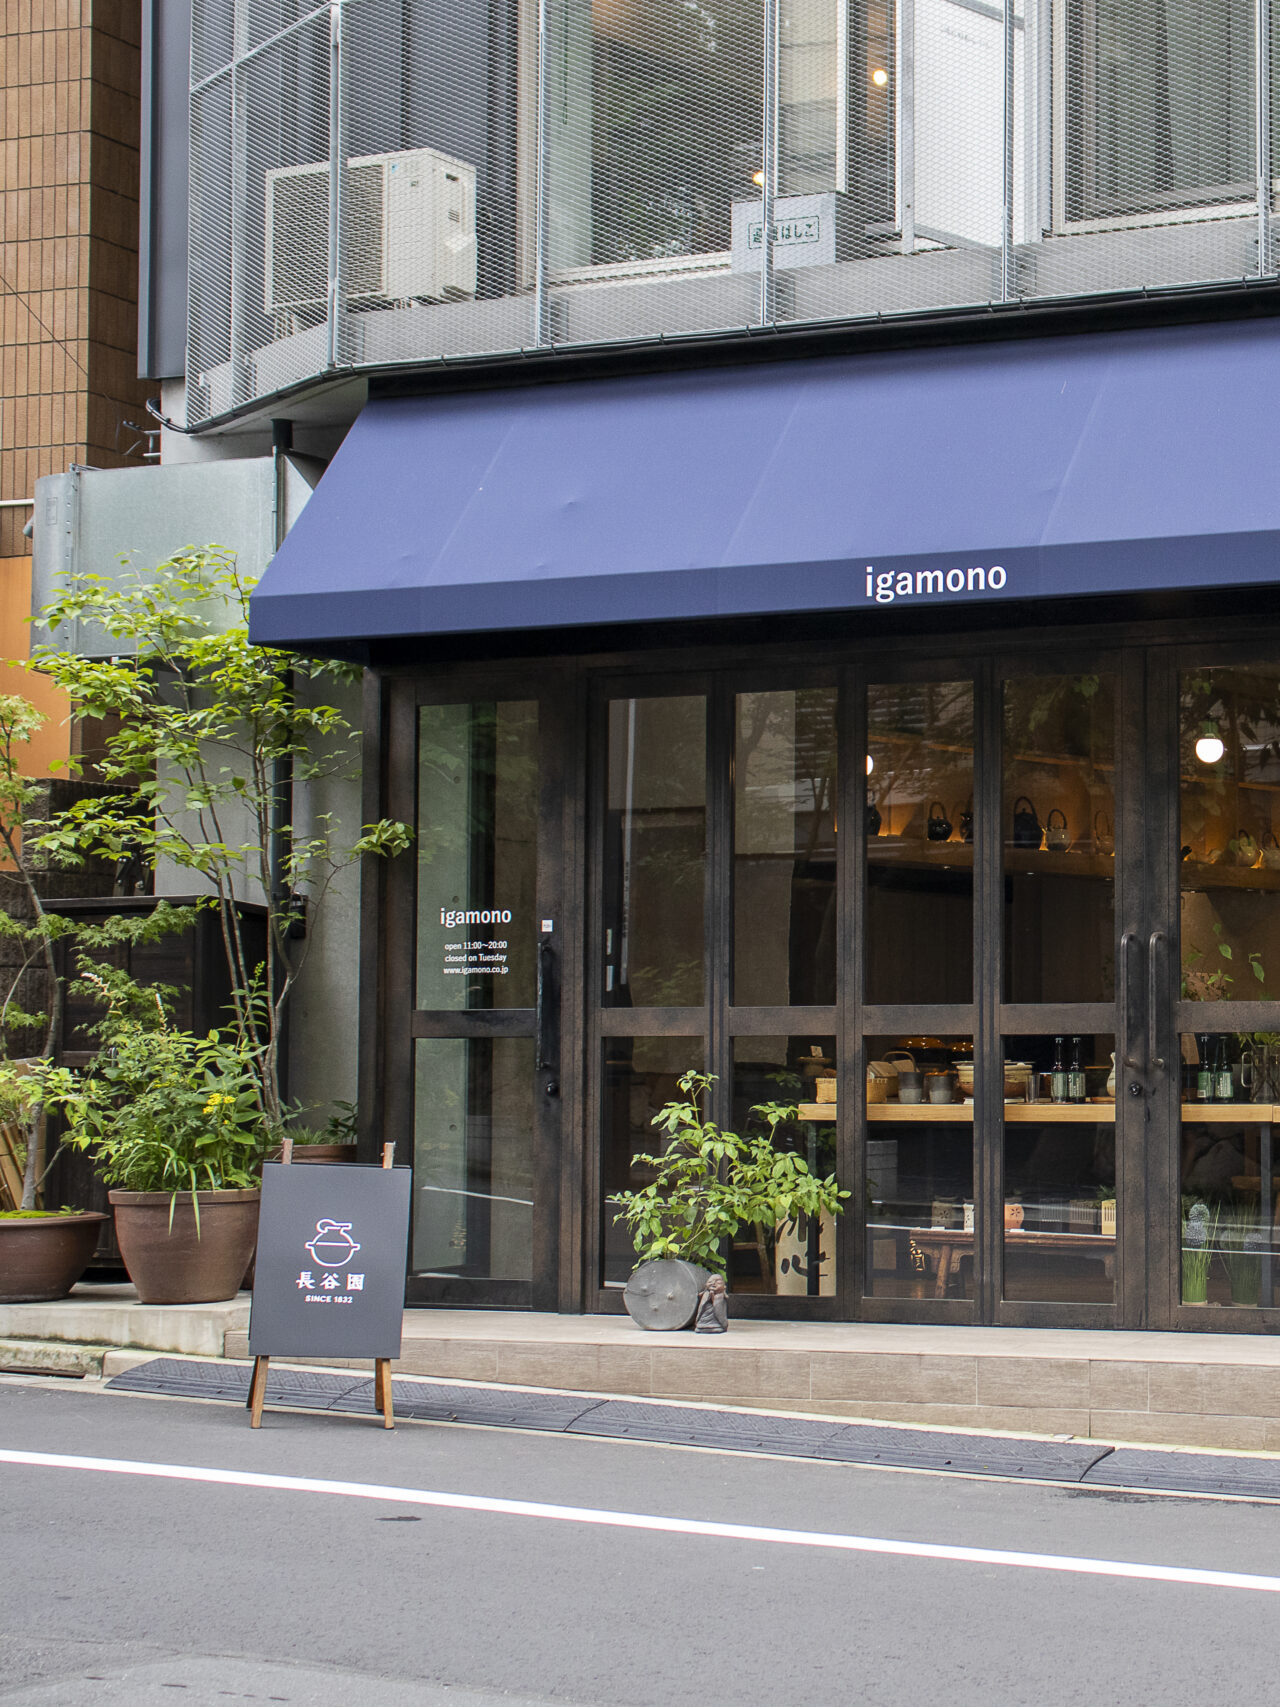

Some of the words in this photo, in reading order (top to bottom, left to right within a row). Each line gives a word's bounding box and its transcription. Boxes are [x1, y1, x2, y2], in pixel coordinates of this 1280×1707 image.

[865, 565, 1007, 603] igamono
[440, 907, 512, 928] igamono
[444, 943, 462, 951] open
[478, 953, 507, 962] Tuesday
[443, 966, 509, 975] www.igamono.co.jp
[295, 1271, 365, 1291] 長谷園
[305, 1294, 332, 1303] SINCE
[333, 1295, 353, 1304] 1832
